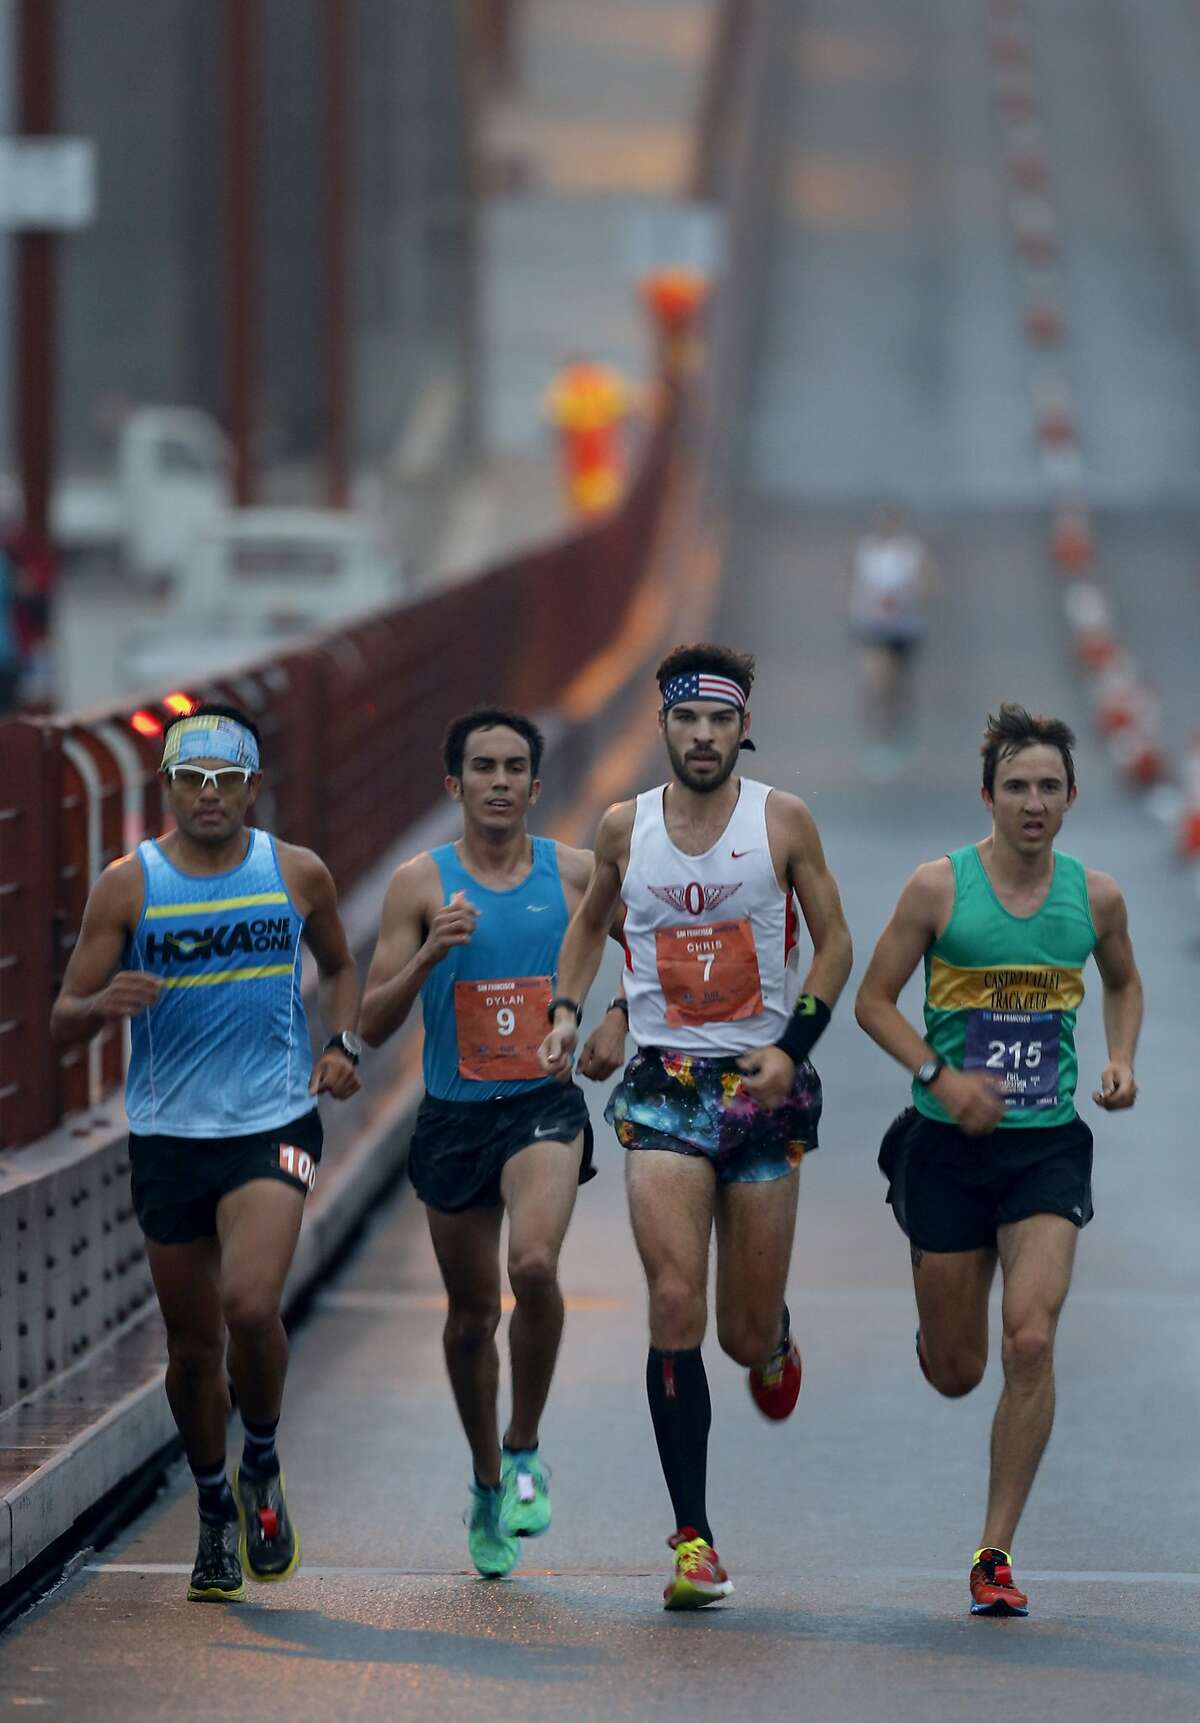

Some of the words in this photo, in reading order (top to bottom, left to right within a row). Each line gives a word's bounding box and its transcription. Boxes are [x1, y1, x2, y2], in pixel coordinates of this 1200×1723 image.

[146, 920, 253, 964] HOKA
[250, 917, 290, 935] ONE
[697, 953, 715, 982] 7
[984, 970, 1023, 989] CASTRO
[486, 995, 524, 1006] DYLAN
[991, 991, 1022, 1010] TRACK
[1023, 991, 1048, 1009] CLUB
[496, 1007, 515, 1036] 9
[993, 1012, 1003, 1022] SAN
[1003, 1012, 1031, 1023] FRANCISCO
[985, 1040, 1042, 1069] 215
